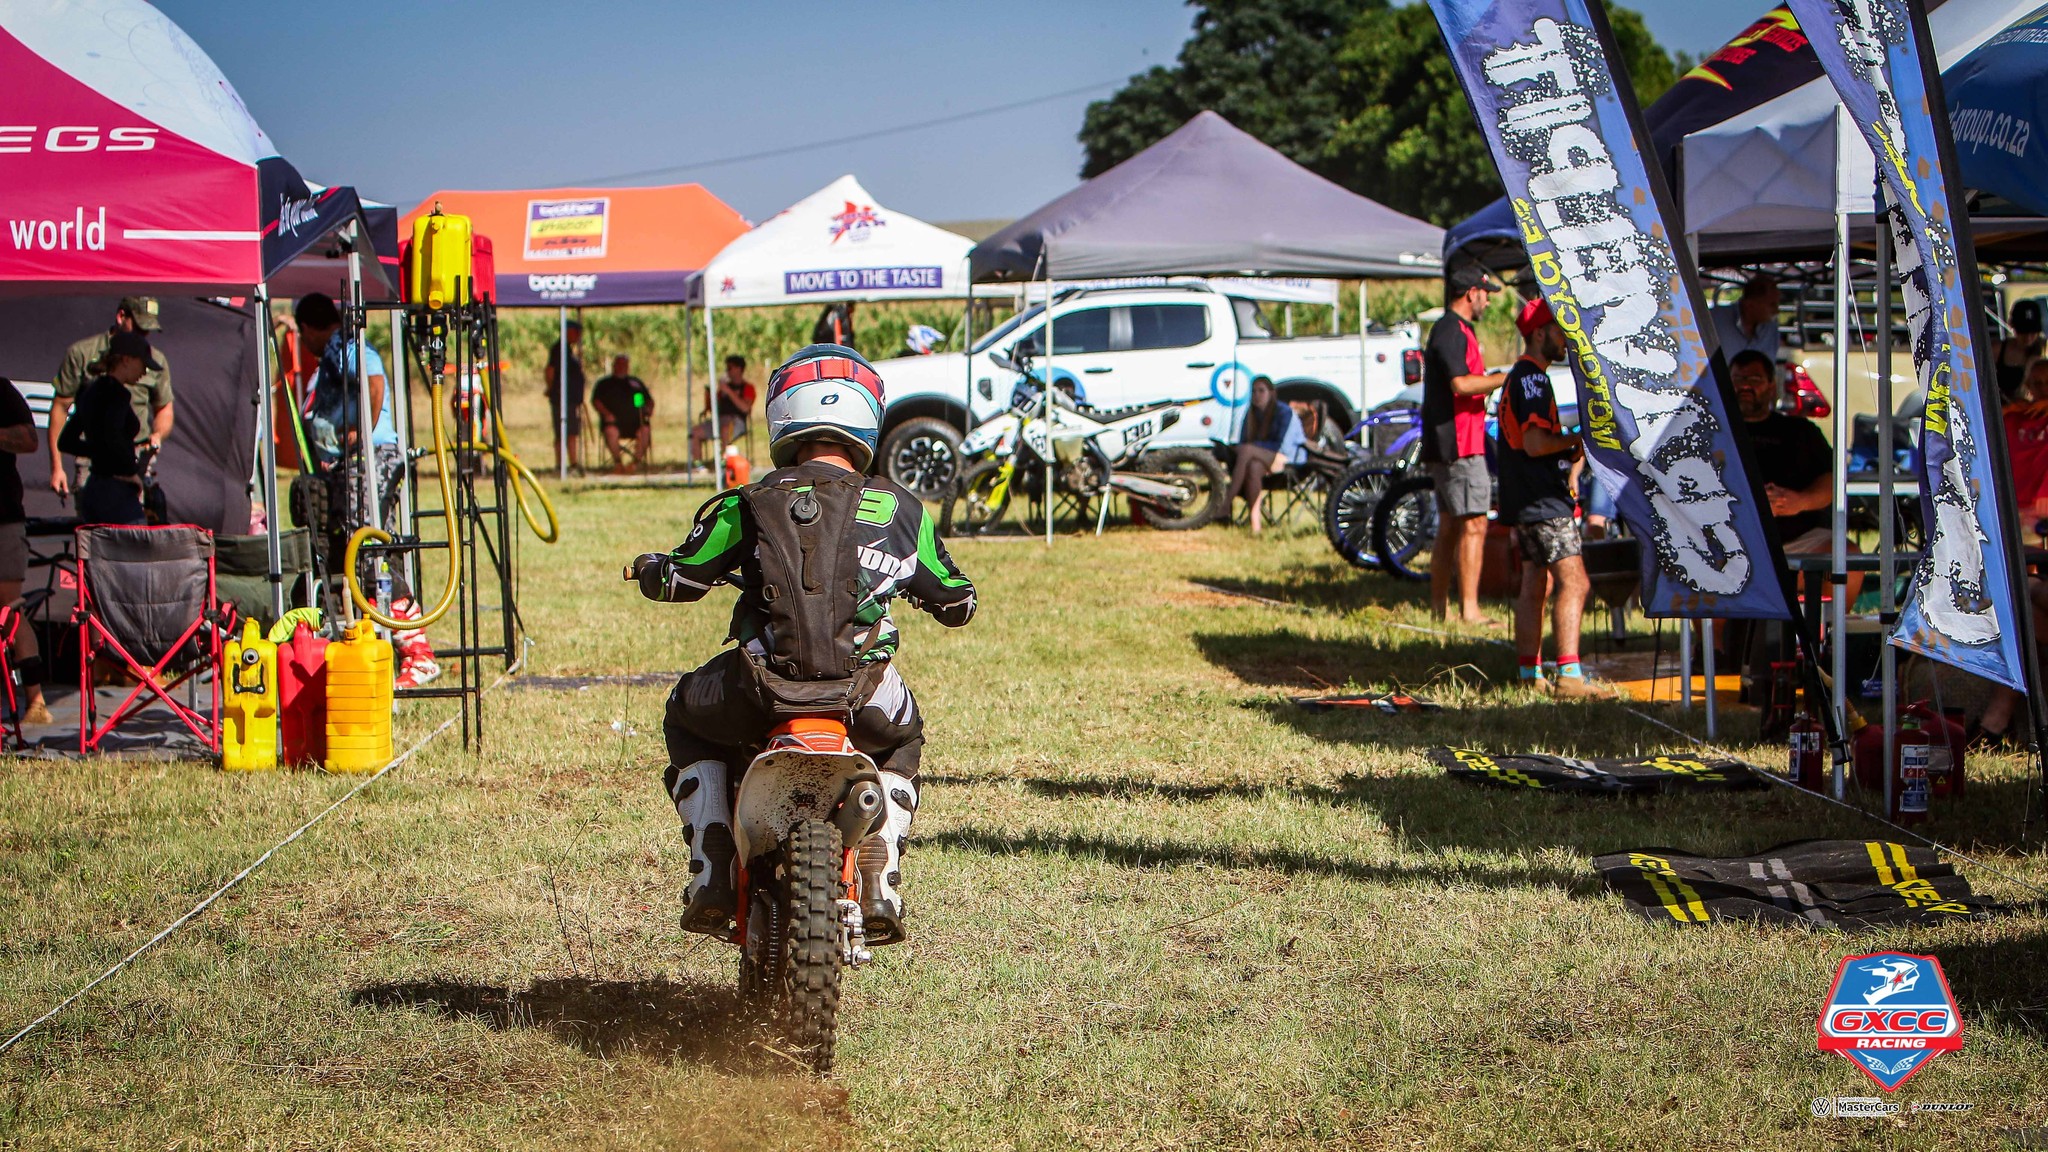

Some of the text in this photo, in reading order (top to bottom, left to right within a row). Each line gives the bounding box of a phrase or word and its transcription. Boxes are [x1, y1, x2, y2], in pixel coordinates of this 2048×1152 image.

[9, 207, 106, 250] world
[528, 273, 598, 292] brother
[790, 268, 938, 292] MOVE TO THE TASTE
